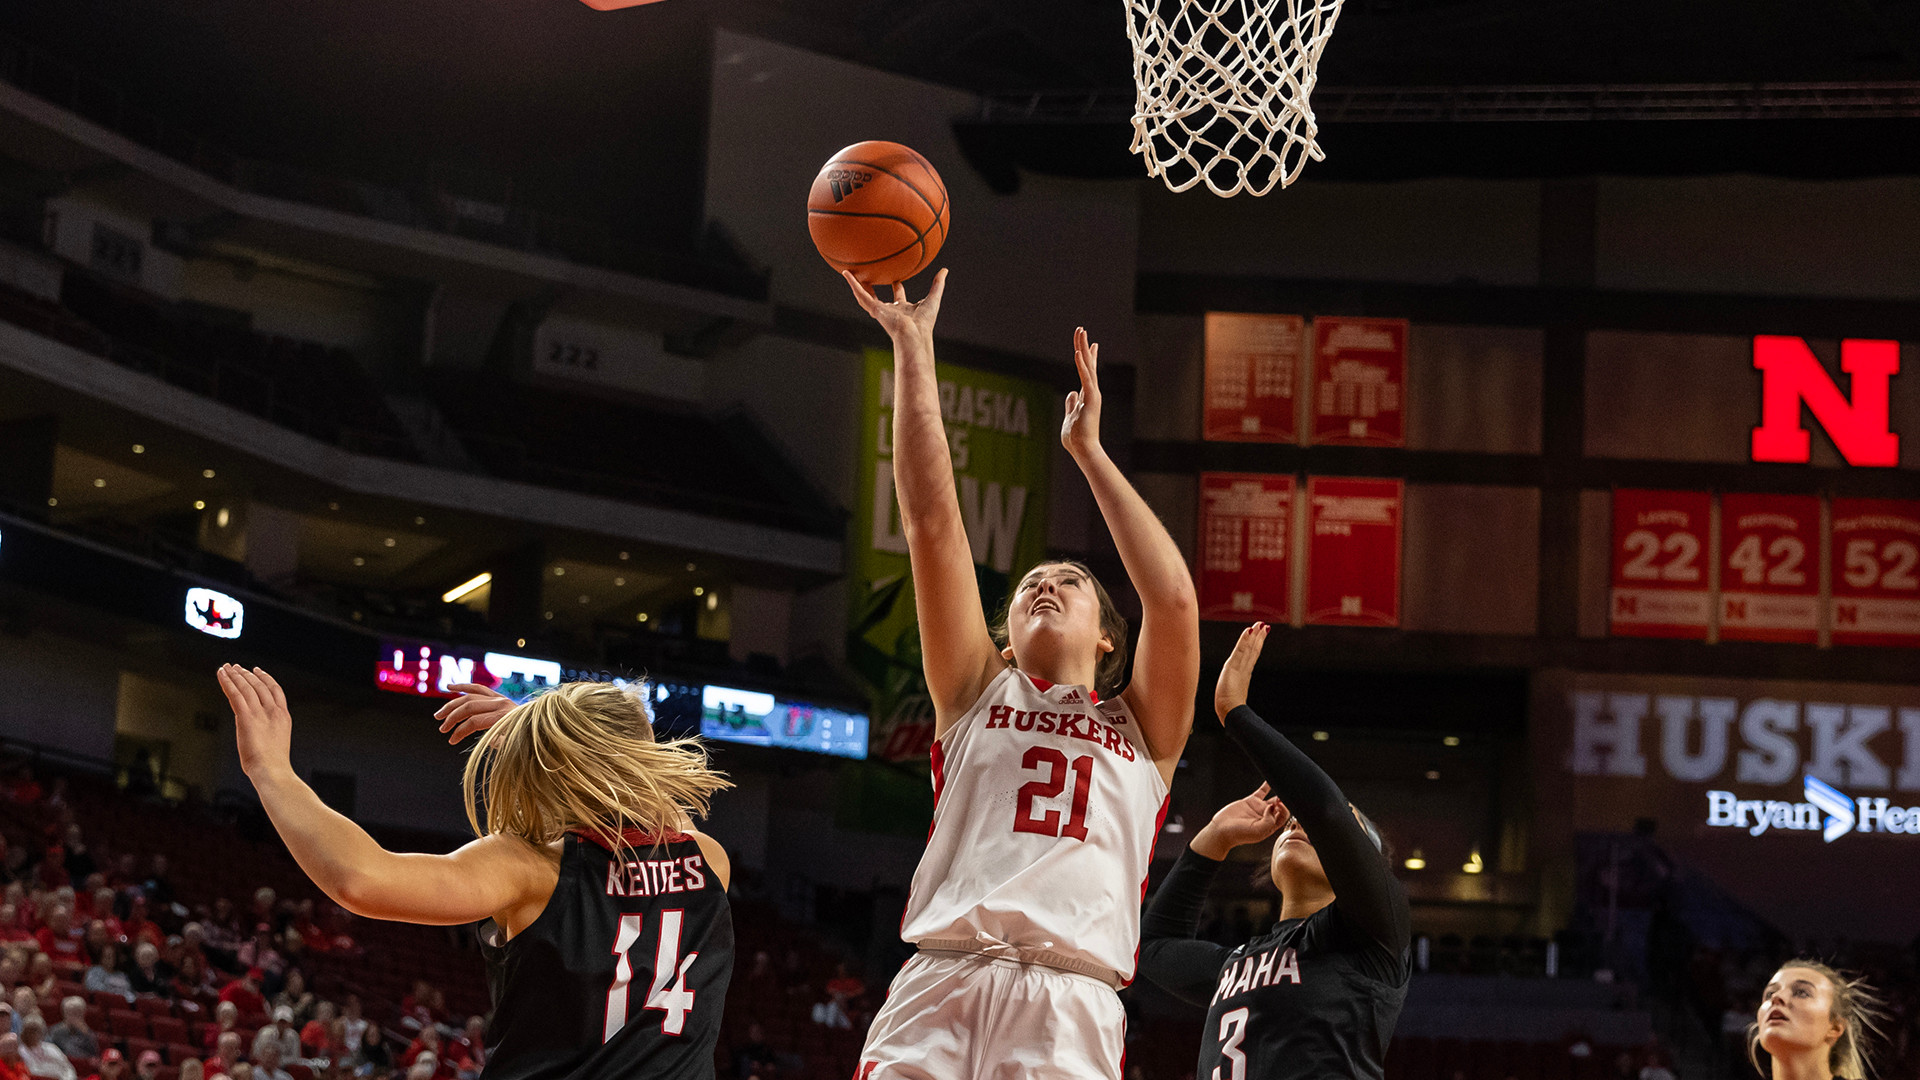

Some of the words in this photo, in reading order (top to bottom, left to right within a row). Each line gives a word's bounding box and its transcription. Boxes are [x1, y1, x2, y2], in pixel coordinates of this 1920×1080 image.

[549, 340, 600, 370] 222
[878, 366, 1031, 438] NRASKA
[1752, 335, 1900, 467] N
[1622, 529, 1701, 581] 22
[1728, 534, 1807, 586] 42
[1843, 538, 1920, 590] 52
[1058, 697, 1084, 705] adidas
[985, 704, 1136, 763] HUSKERS
[1012, 745, 1094, 843] 21
[1705, 789, 1822, 838] Bryan
[1854, 796, 1920, 835] Hea
[602, 908, 699, 1045] 14
[1211, 1006, 1250, 1080] 3
